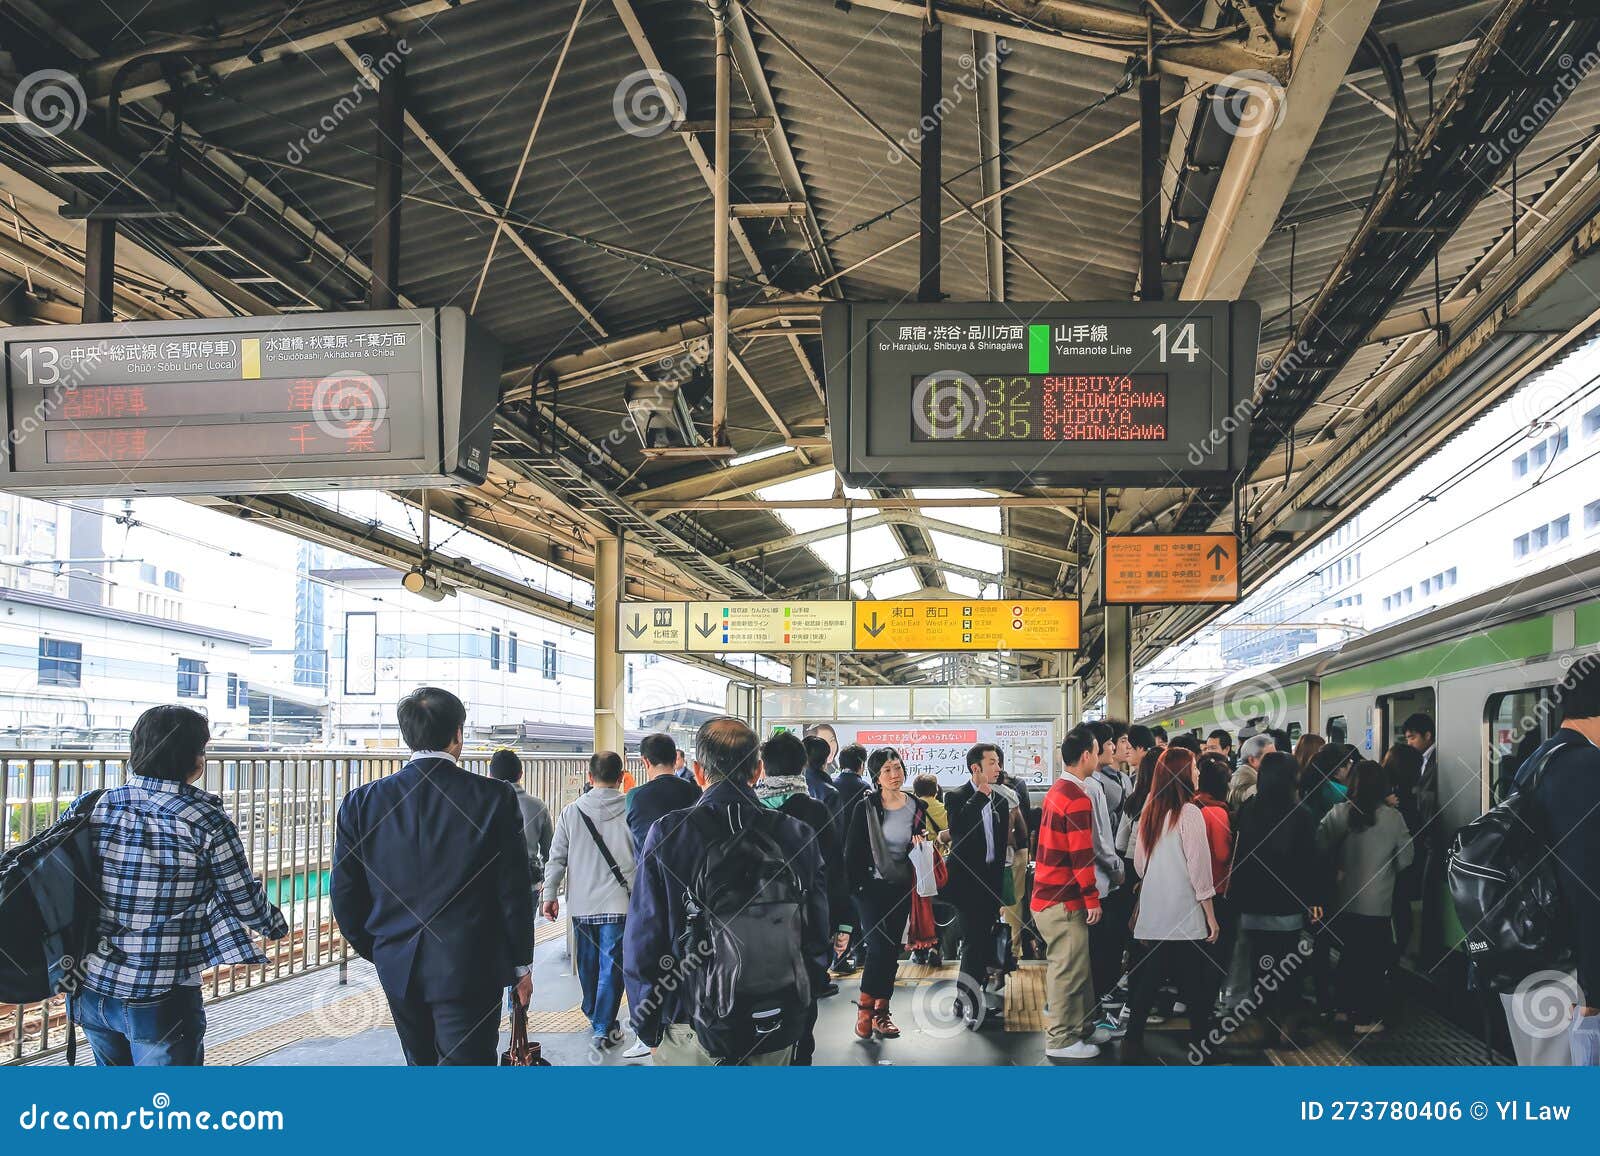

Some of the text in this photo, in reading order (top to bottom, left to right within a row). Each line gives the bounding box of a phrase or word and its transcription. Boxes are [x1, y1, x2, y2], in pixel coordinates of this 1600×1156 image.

[1055, 324, 1108, 343] 山手線
[879, 342, 1024, 352] for Harajuku, Shibuya & Shinagawa
[1055, 345, 1132, 355] Yamanote Line
[1151, 323, 1200, 363] 14
[323, 350, 362, 359] Akihabara
[372, 348, 395, 357] Chiba
[20, 347, 60, 385] 13
[184, 361, 203, 371] Line
[206, 359, 237, 371] (Local)
[1043, 376, 1132, 392] SHIBUYA
[927, 377, 1031, 407] 11:32
[1043, 392, 1165, 408] & SHINAGAWA
[1043, 408, 1132, 424] SHIBUYA
[927, 409, 1031, 439] 11:35
[1043, 425, 1165, 440] & SHINAGAWA
[891, 606, 914, 618] 東口
[926, 606, 948, 618] 西口
[653, 629, 679, 639] 化粧室
[1033, 771, 1043, 784] 3
